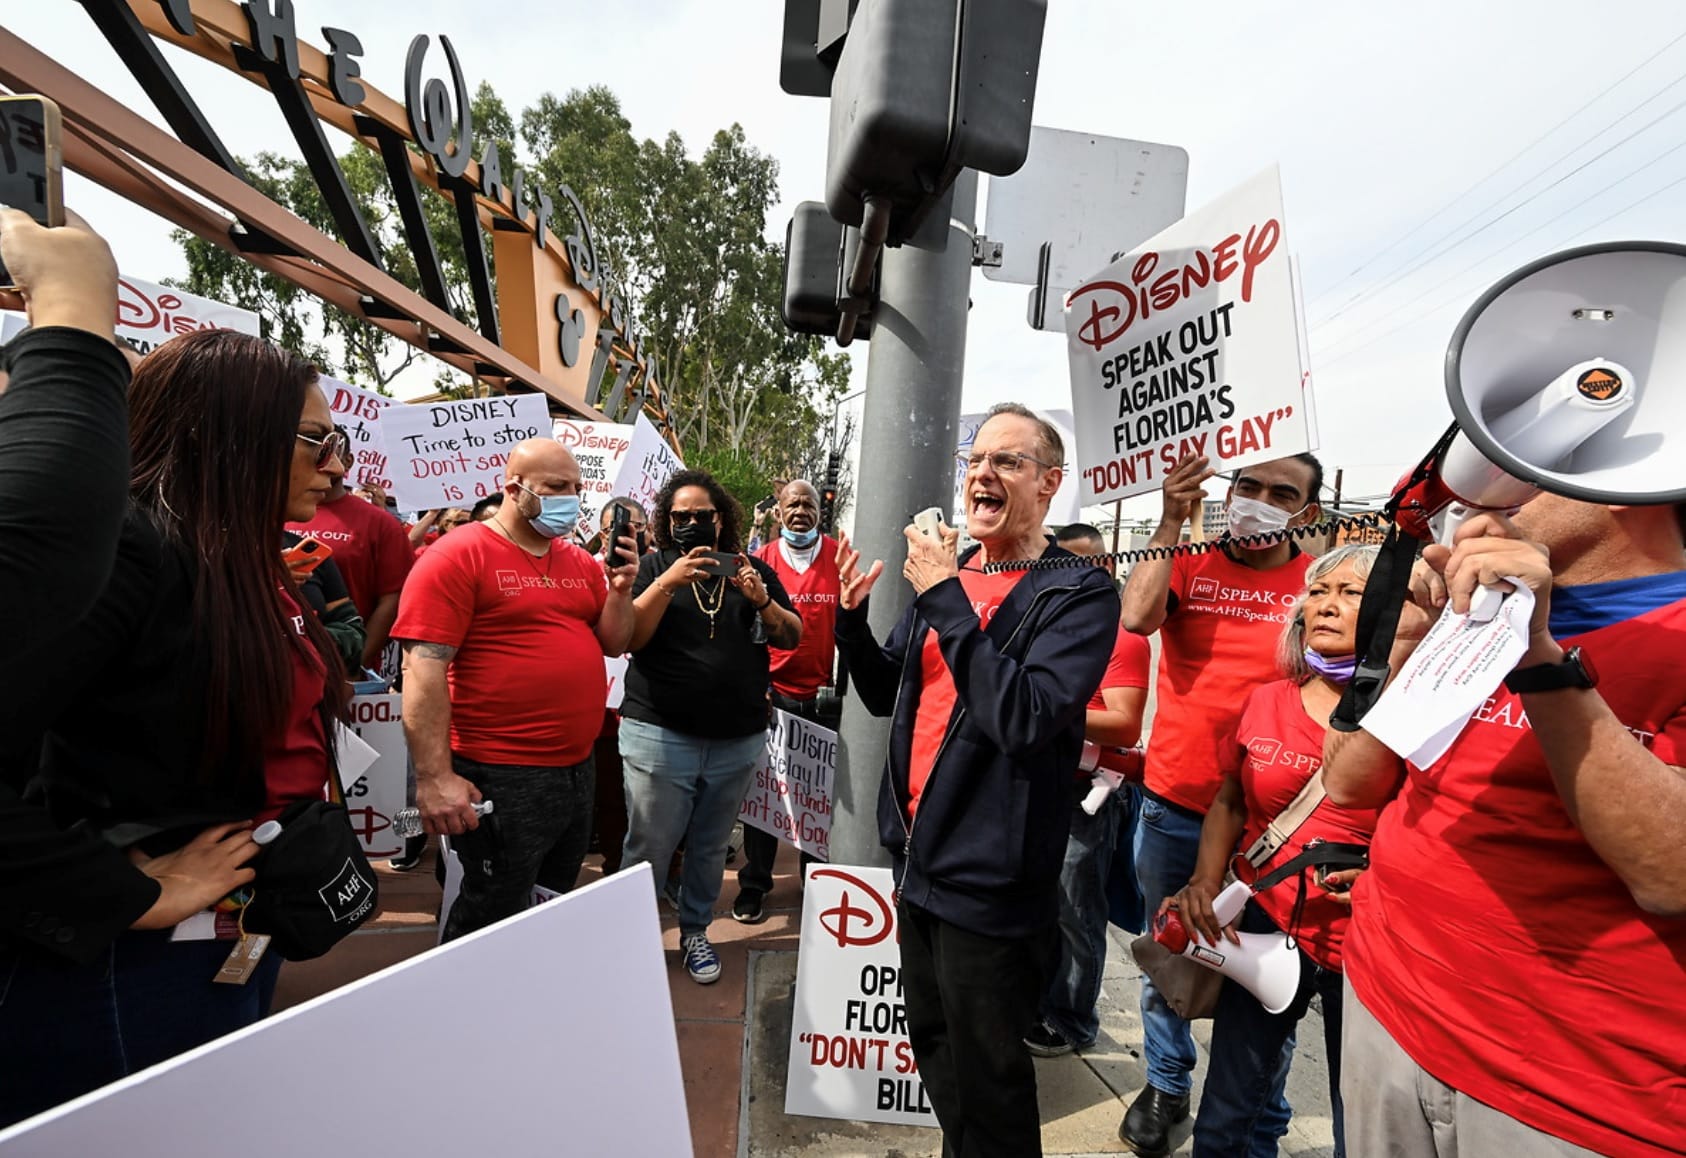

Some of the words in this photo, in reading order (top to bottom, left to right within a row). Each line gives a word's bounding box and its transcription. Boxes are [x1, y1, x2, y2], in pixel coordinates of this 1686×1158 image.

[1066, 219, 1280, 351] DISNEY
[1101, 330, 1175, 389] SPEAK
[1179, 301, 1234, 346] OUT
[1118, 349, 1219, 418] AGAINST
[430, 399, 518, 427] DISNEY
[1113, 385, 1234, 453] FLORIDA'S
[402, 434, 460, 454] Time
[463, 428, 485, 447] to
[494, 424, 538, 444] stop
[555, 421, 629, 460] DISNEY
[1159, 432, 1208, 475] SAY
[357, 450, 387, 475] say
[410, 451, 471, 478] Don't
[442, 482, 464, 501] is
[475, 482, 487, 497] a
[322, 531, 351, 541] OUT
[562, 578, 588, 589] OUT
[814, 593, 835, 603] OUT
[1195, 584, 1213, 593] AHF
[1219, 588, 1276, 605] SPEAK
[1252, 744, 1273, 754] AHF
[756, 767, 789, 802] stop
[336, 874, 361, 905] AHF
[877, 1078, 931, 1113] BILL
